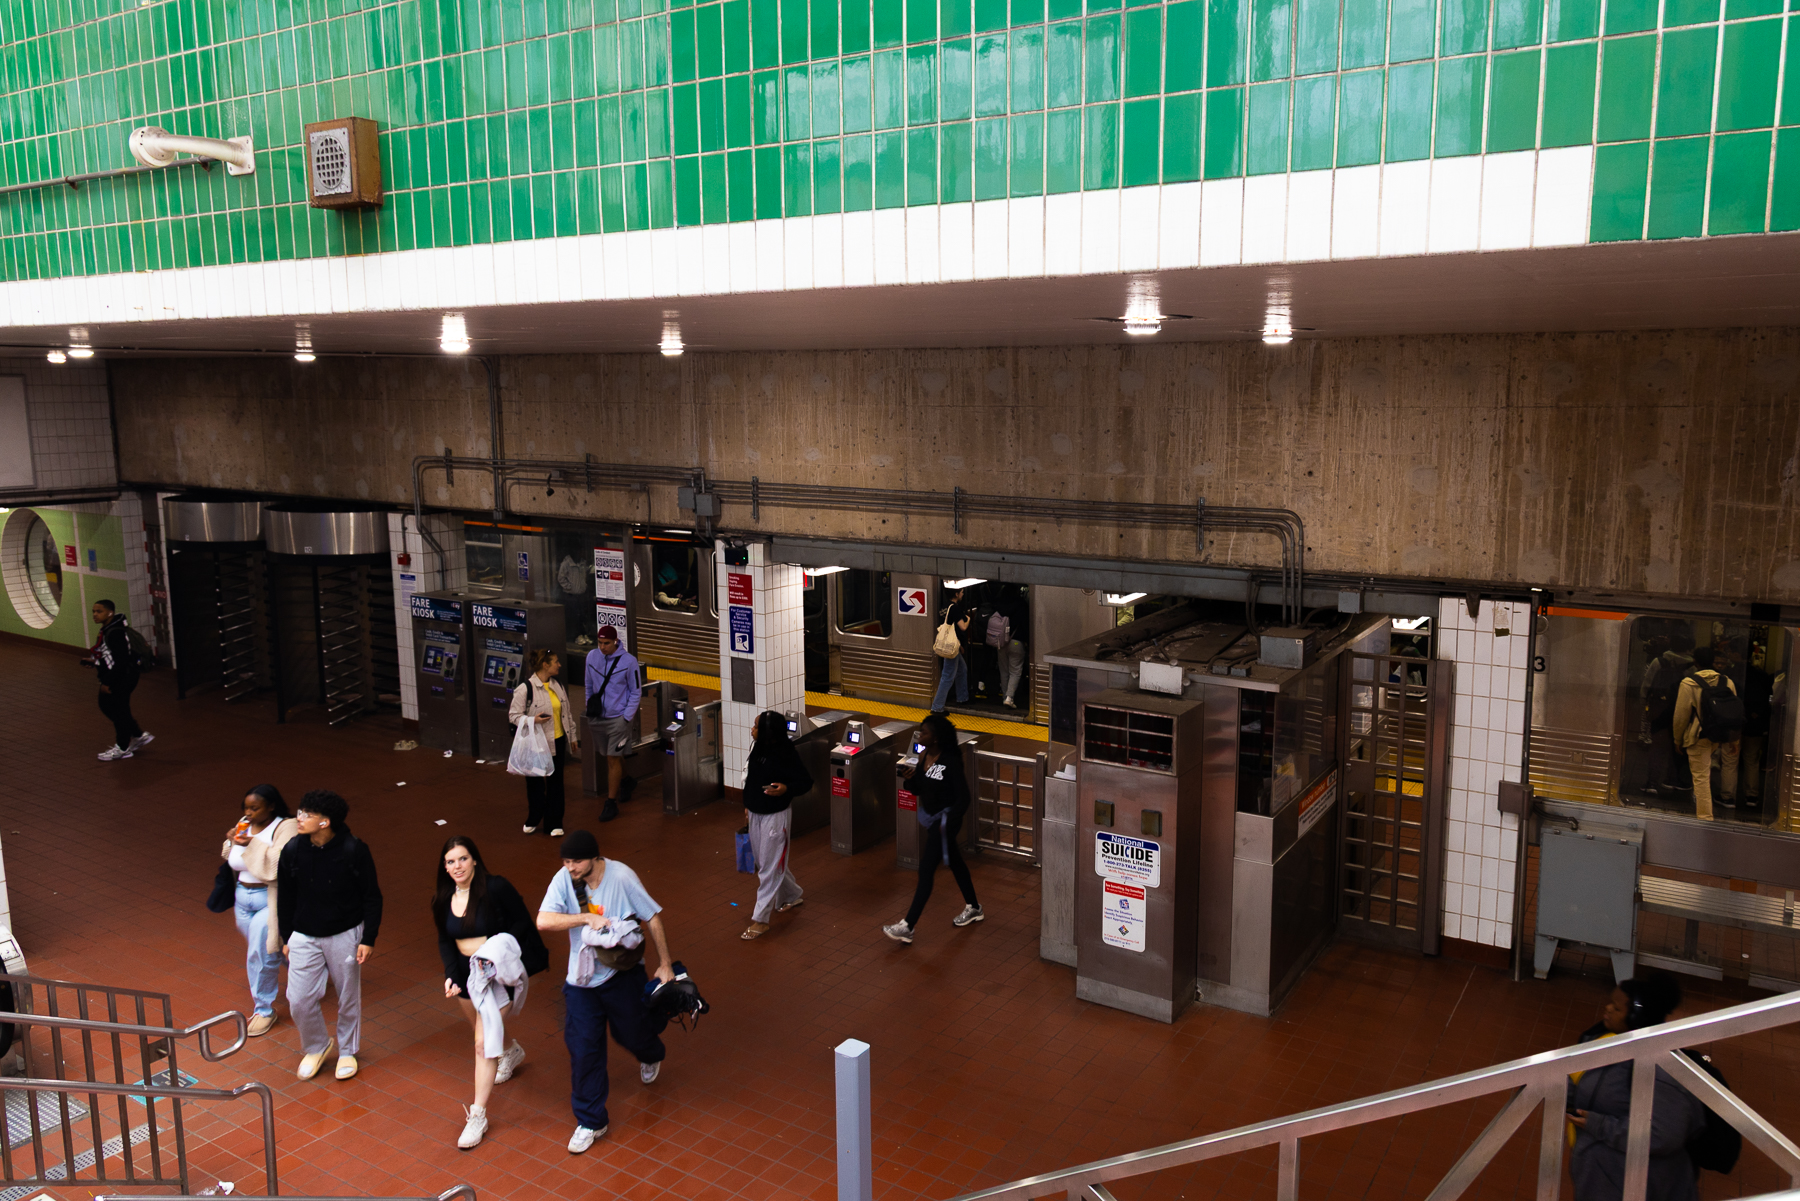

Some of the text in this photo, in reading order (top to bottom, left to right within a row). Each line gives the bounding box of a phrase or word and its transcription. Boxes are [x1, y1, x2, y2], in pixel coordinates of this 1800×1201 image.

[411, 597, 430, 608] FARE
[412, 608, 435, 619] KIOSK
[472, 605, 493, 616] FARE
[473, 616, 498, 628] KIOSK
[1534, 656, 1546, 672] 3
[1111, 835, 1144, 848] National
[1101, 841, 1153, 863] SUICIDE
[1102, 854, 1153, 868] Prevention Lifeline
[1103, 860, 1136, 870] 1-800-273-TALK
